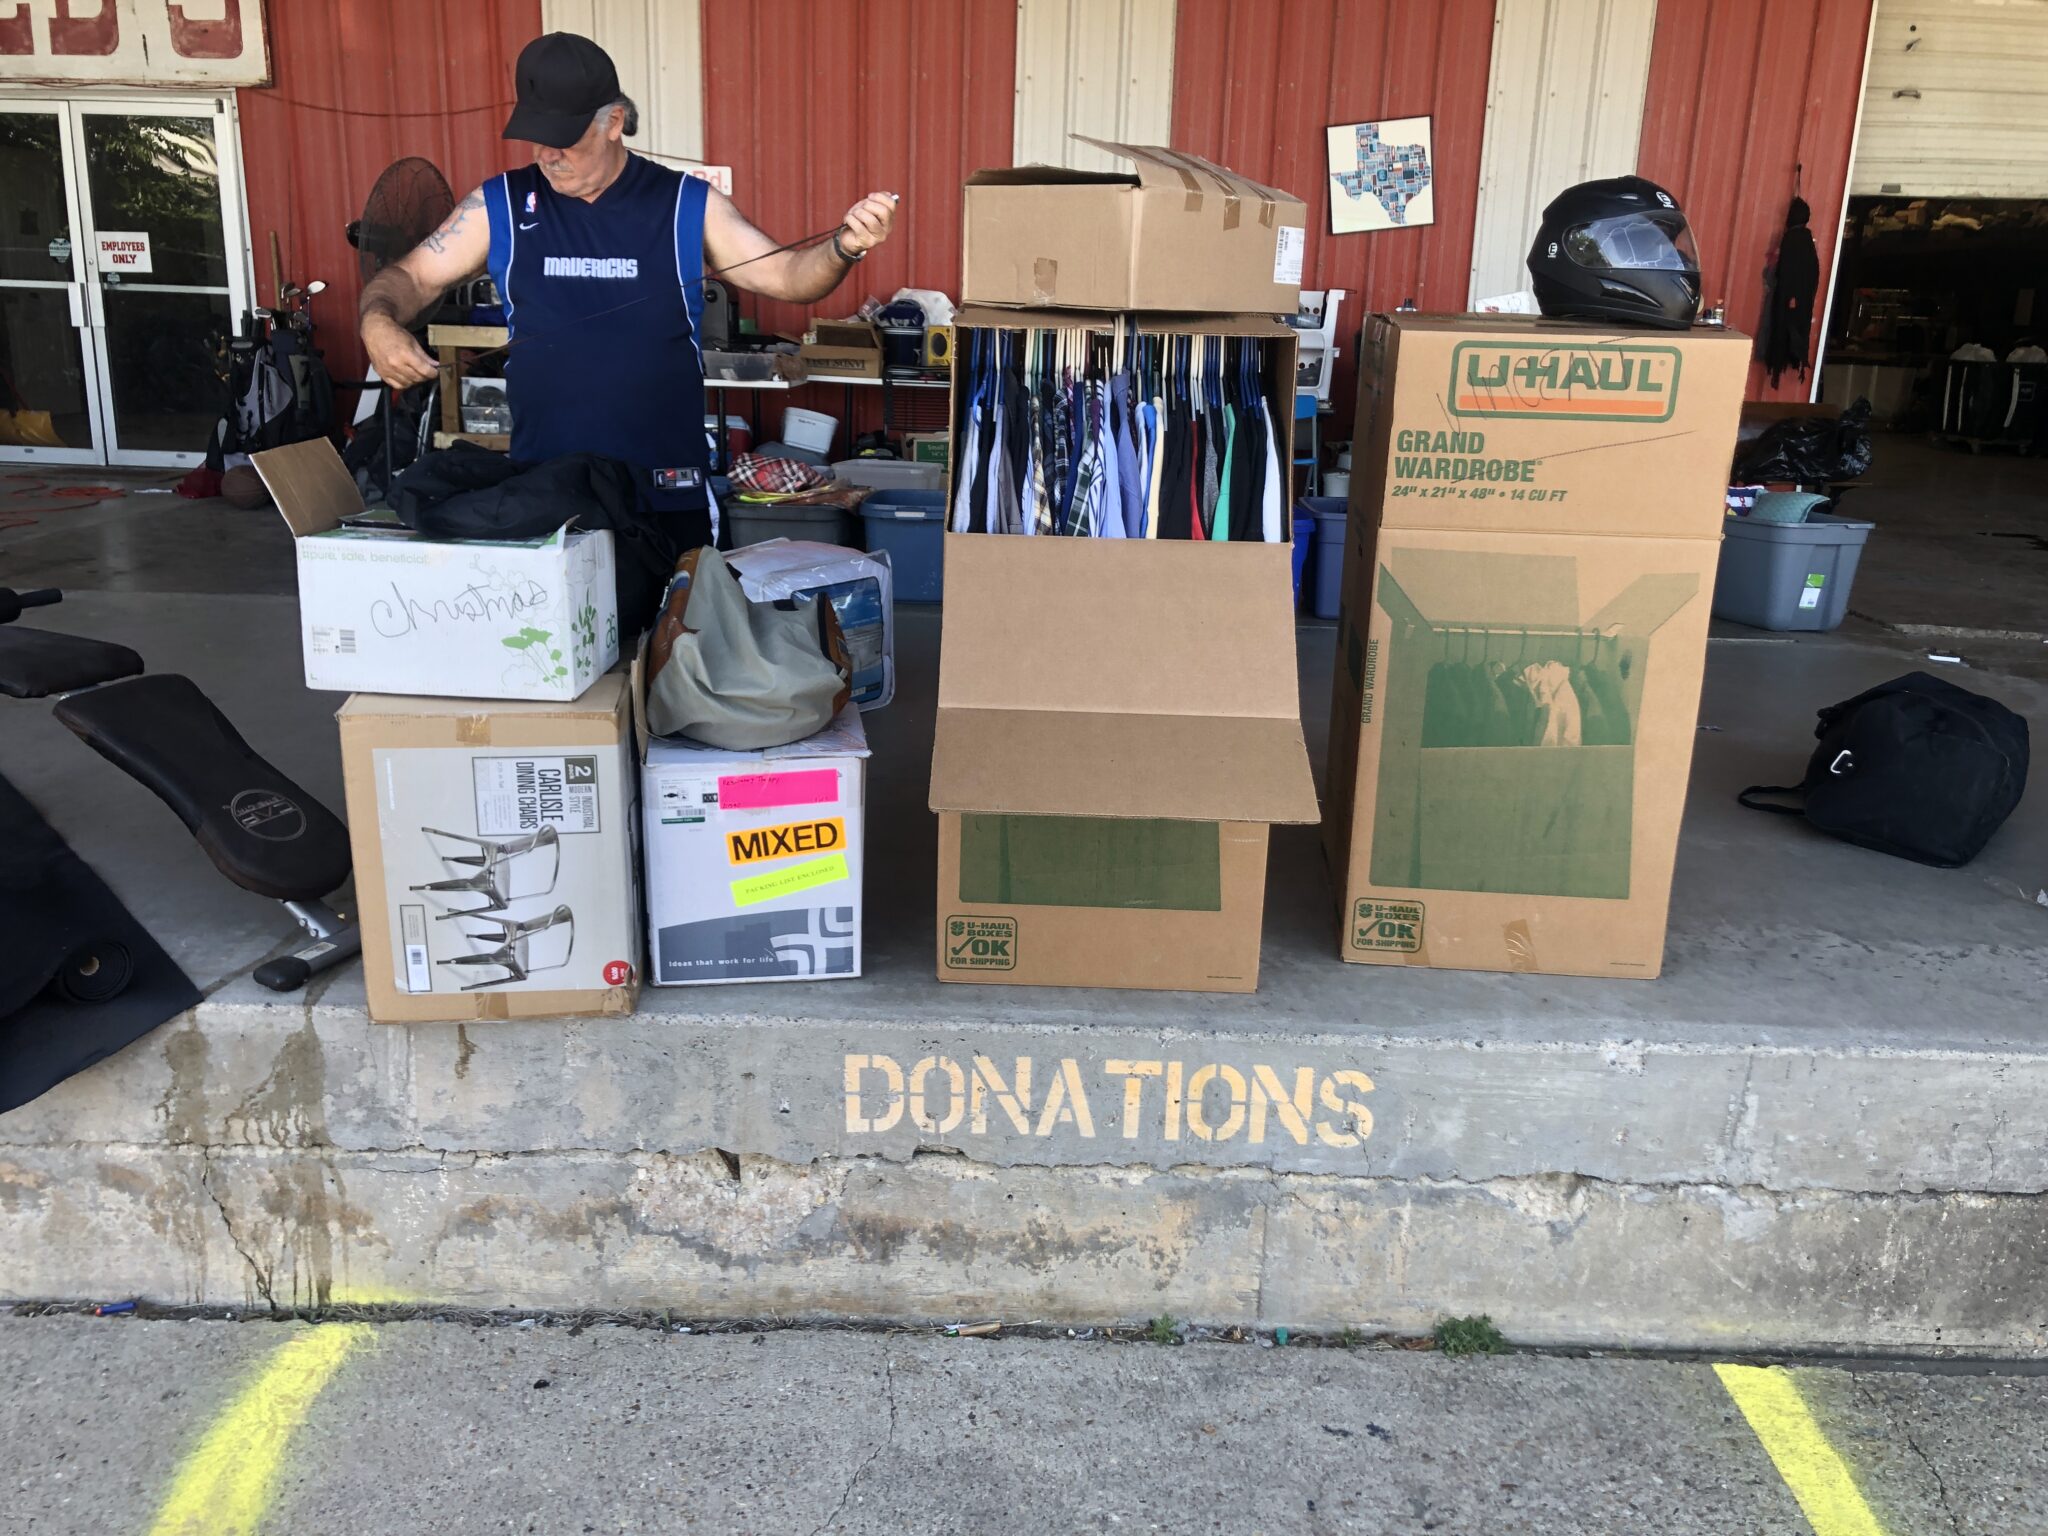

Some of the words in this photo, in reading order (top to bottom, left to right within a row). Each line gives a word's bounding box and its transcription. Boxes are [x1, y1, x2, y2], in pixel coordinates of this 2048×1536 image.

[101, 241, 145, 251] EMPLOYEES
[112, 254, 137, 264] ONLY
[543, 256, 638, 279] MAVERICKS
[1396, 429, 1485, 455] GRAND
[1394, 456, 1536, 482] WARDROBE
[1510, 488, 1526, 500] 14
[1528, 489, 1547, 501] CU
[1549, 490, 1568, 502] FT
[1364, 639, 1378, 690] WARDROBE
[1361, 692, 1373, 724] GRAND
[515, 761, 537, 795] DINING
[567, 764, 575, 779] pack
[575, 766, 591, 777] 2
[537, 768, 564, 822] CARLISLE
[569, 785, 593, 794] MODERN
[517, 796, 539, 829] CHAIRS
[569, 796, 581, 814] STYLE
[581, 795, 595, 829] INDUSTRIAL
[731, 822, 838, 861] MIXED
[745, 882, 778, 894] PACKING
[779, 877, 796, 886] LIST
[797, 865, 835, 881] ENCLOSED
[1375, 904, 1421, 914] U-HAUL
[1375, 911, 1420, 921] BOXES
[967, 921, 1013, 931] U-HAUL
[967, 929, 1013, 938] BOXES
[1378, 921, 1417, 940] OK
[971, 938, 1010, 957] OK
[1356, 938, 1373, 946] FOR
[1375, 939, 1416, 949] SHIPPING
[950, 956, 967, 965] FOR
[969, 957, 1010, 966] SHIPPING
[844, 1054, 1376, 1149] DONATIONS
